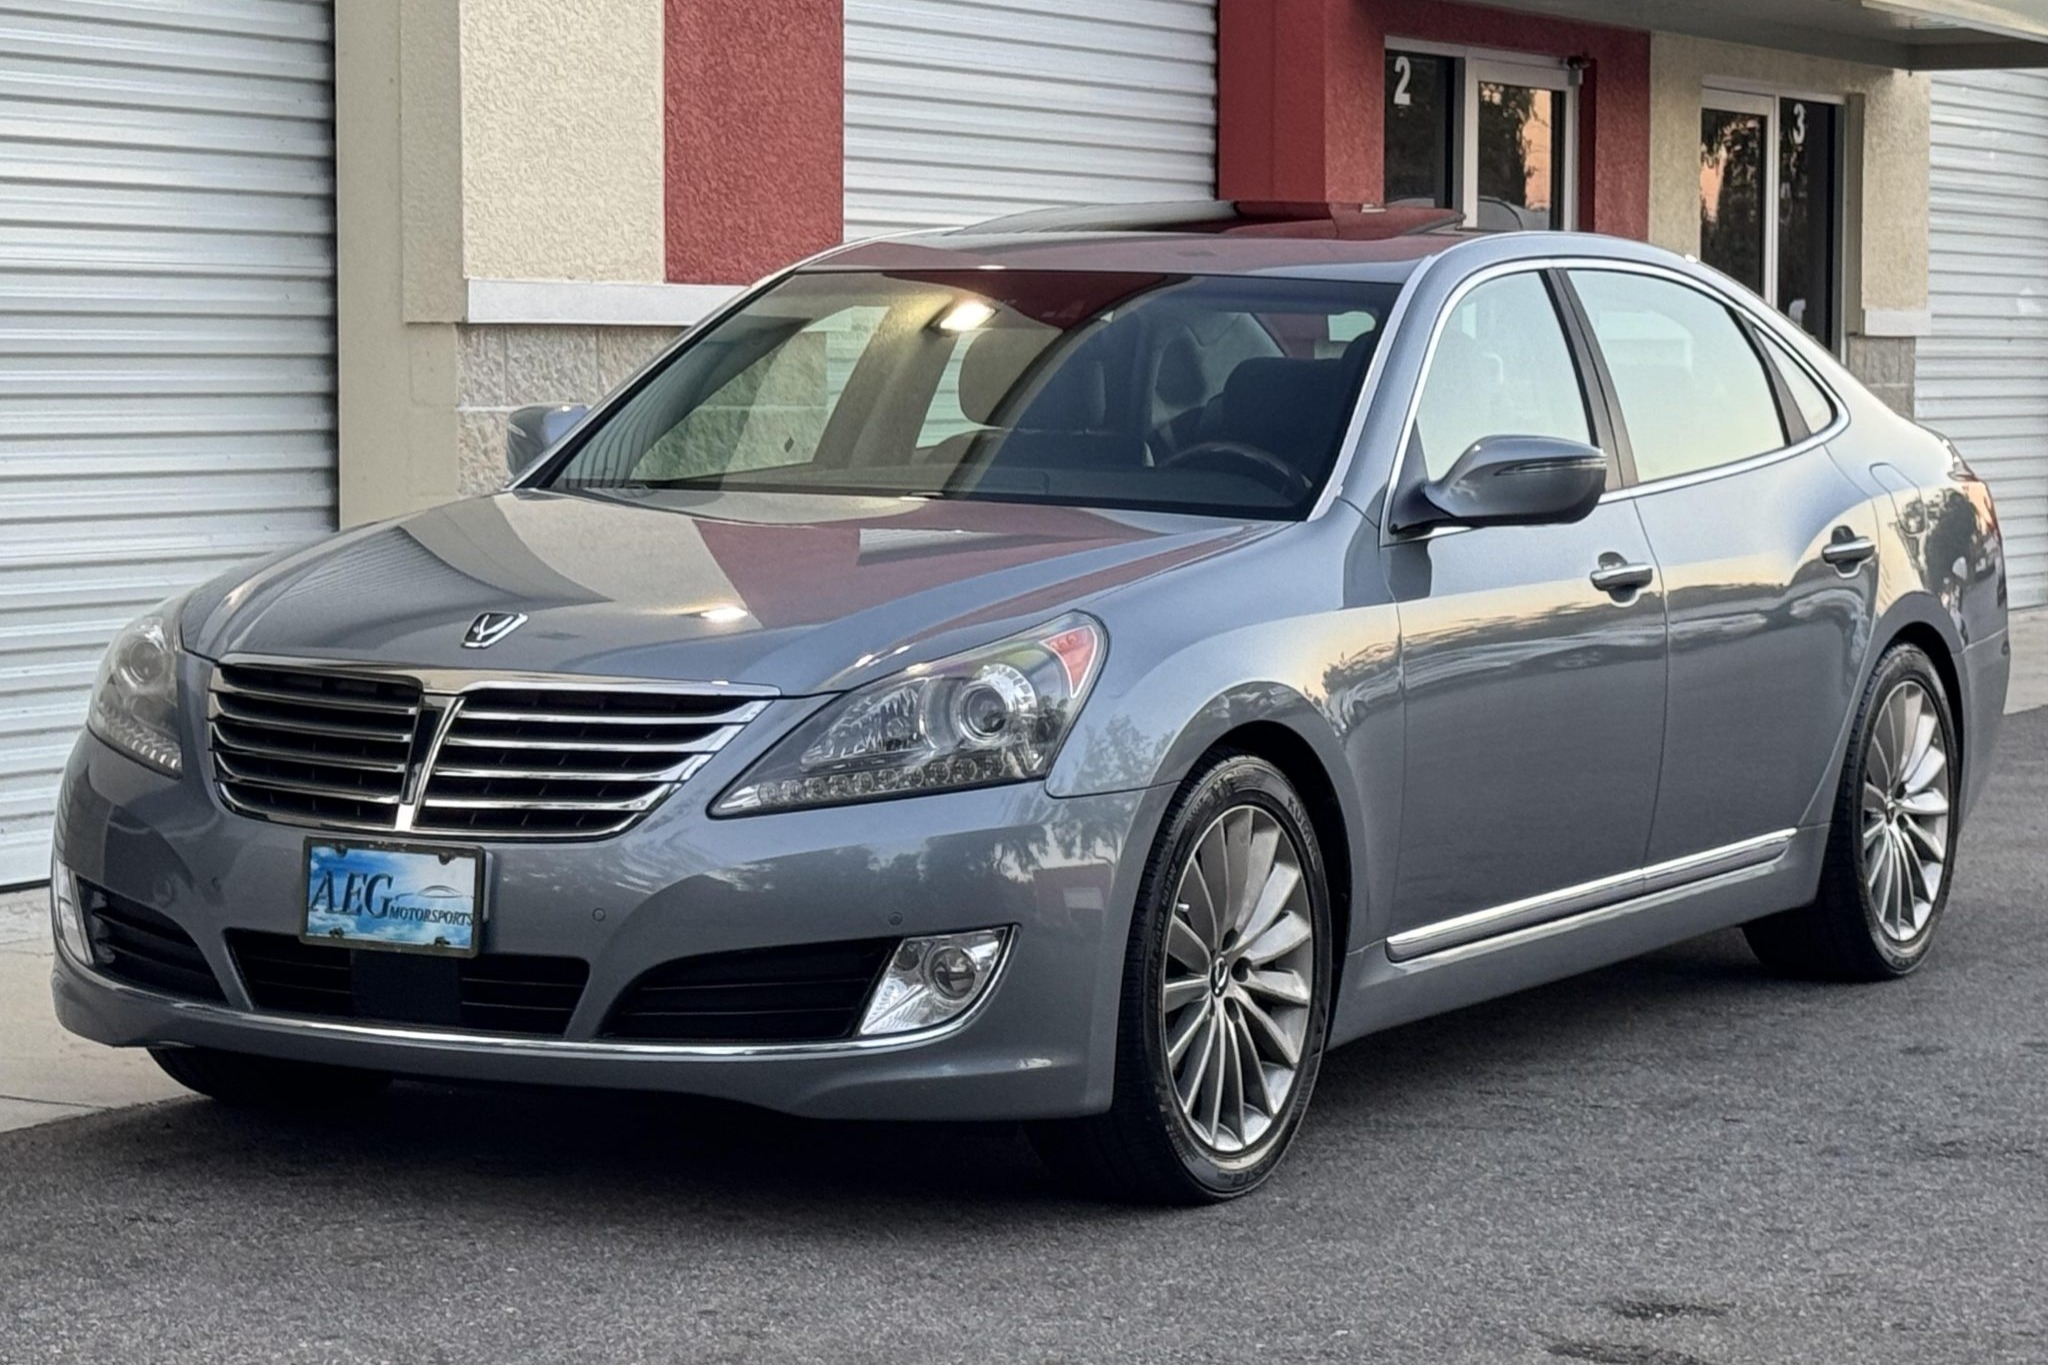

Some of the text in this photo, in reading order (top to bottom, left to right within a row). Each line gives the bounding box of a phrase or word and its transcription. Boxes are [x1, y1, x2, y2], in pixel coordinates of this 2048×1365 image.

[1394, 56, 1411, 105] 2
[1793, 103, 1806, 144] 3
[310, 870, 394, 918] AEG
[389, 905, 473, 926] MOTORSPORTS
